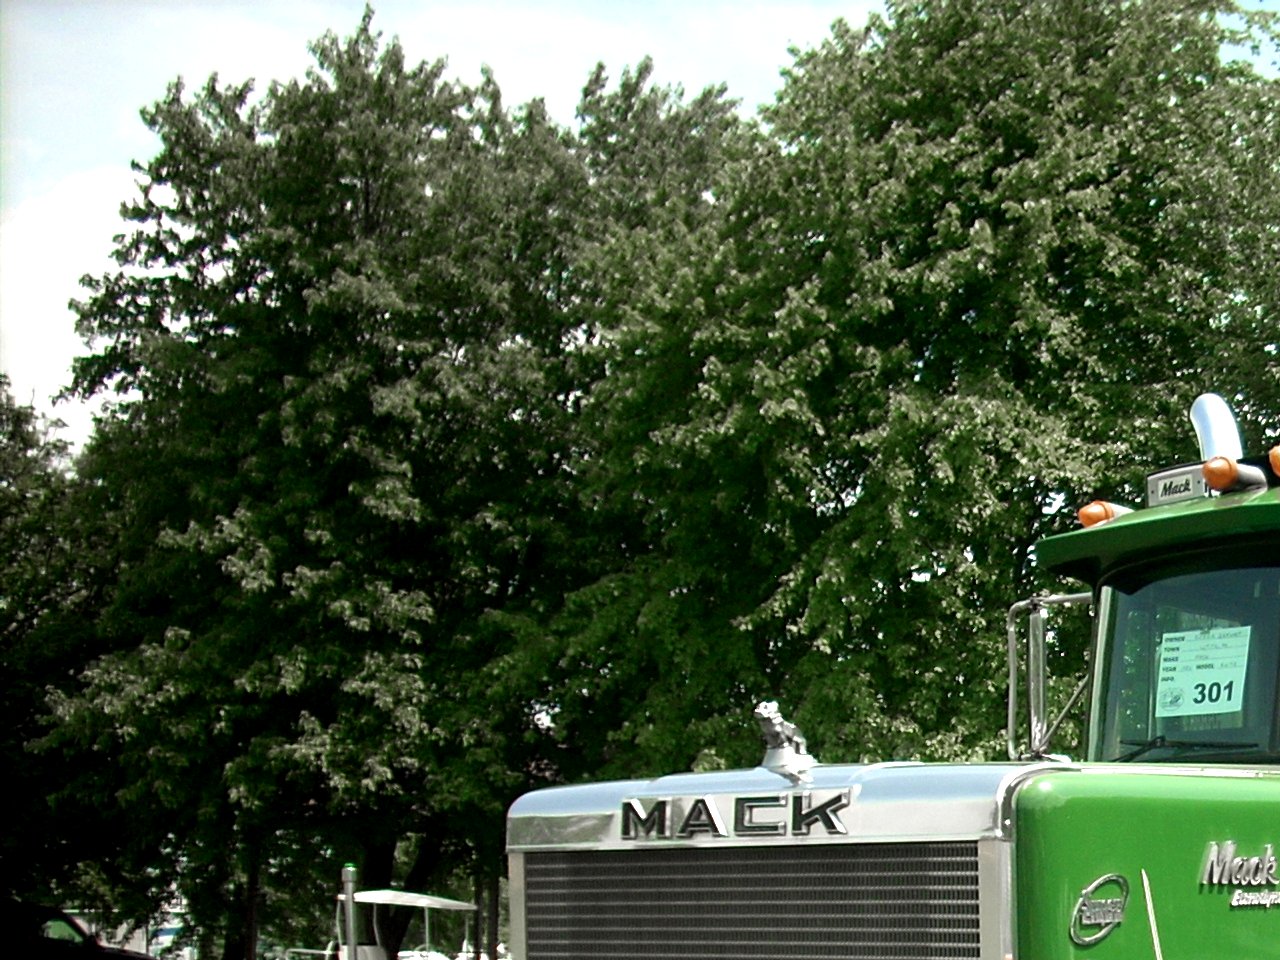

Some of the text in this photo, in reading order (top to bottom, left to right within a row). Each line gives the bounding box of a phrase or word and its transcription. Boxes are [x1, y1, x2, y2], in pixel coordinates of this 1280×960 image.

[1160, 479, 1191, 498] Mack
[1193, 681, 1233, 704] 301
[621, 788, 851, 840] MACK
[1200, 840, 1280, 885] Mack
